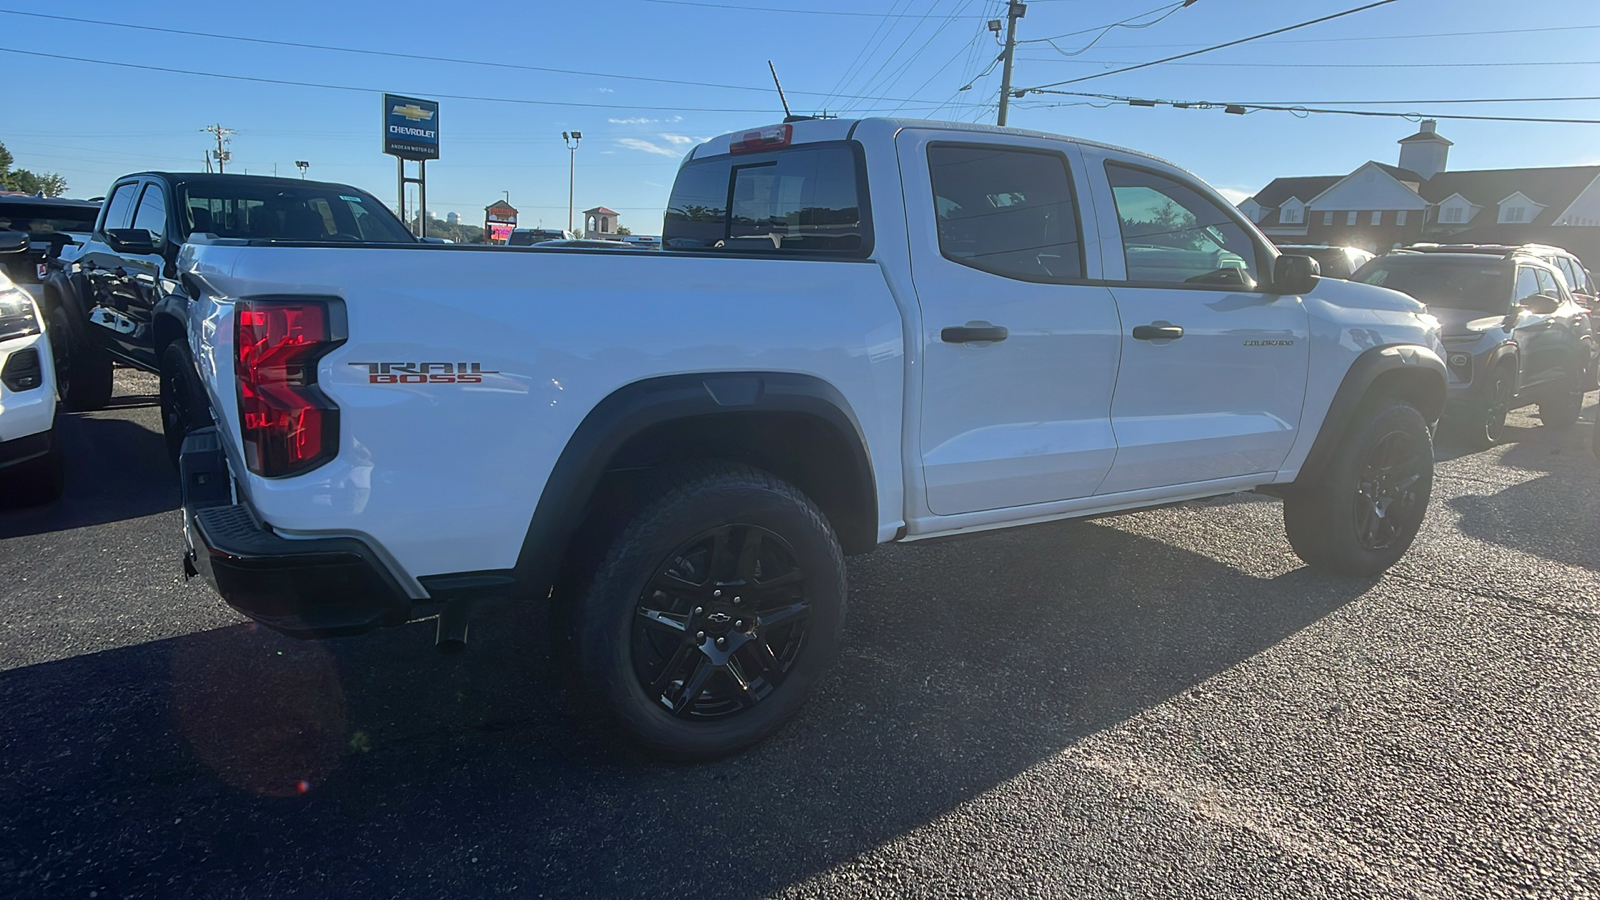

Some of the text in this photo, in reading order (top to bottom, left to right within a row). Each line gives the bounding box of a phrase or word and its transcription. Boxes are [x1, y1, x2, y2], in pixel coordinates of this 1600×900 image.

[390, 125, 435, 138] CHEVROLET
[348, 362, 499, 374] TRAIL
[369, 374, 482, 384] BOSS
